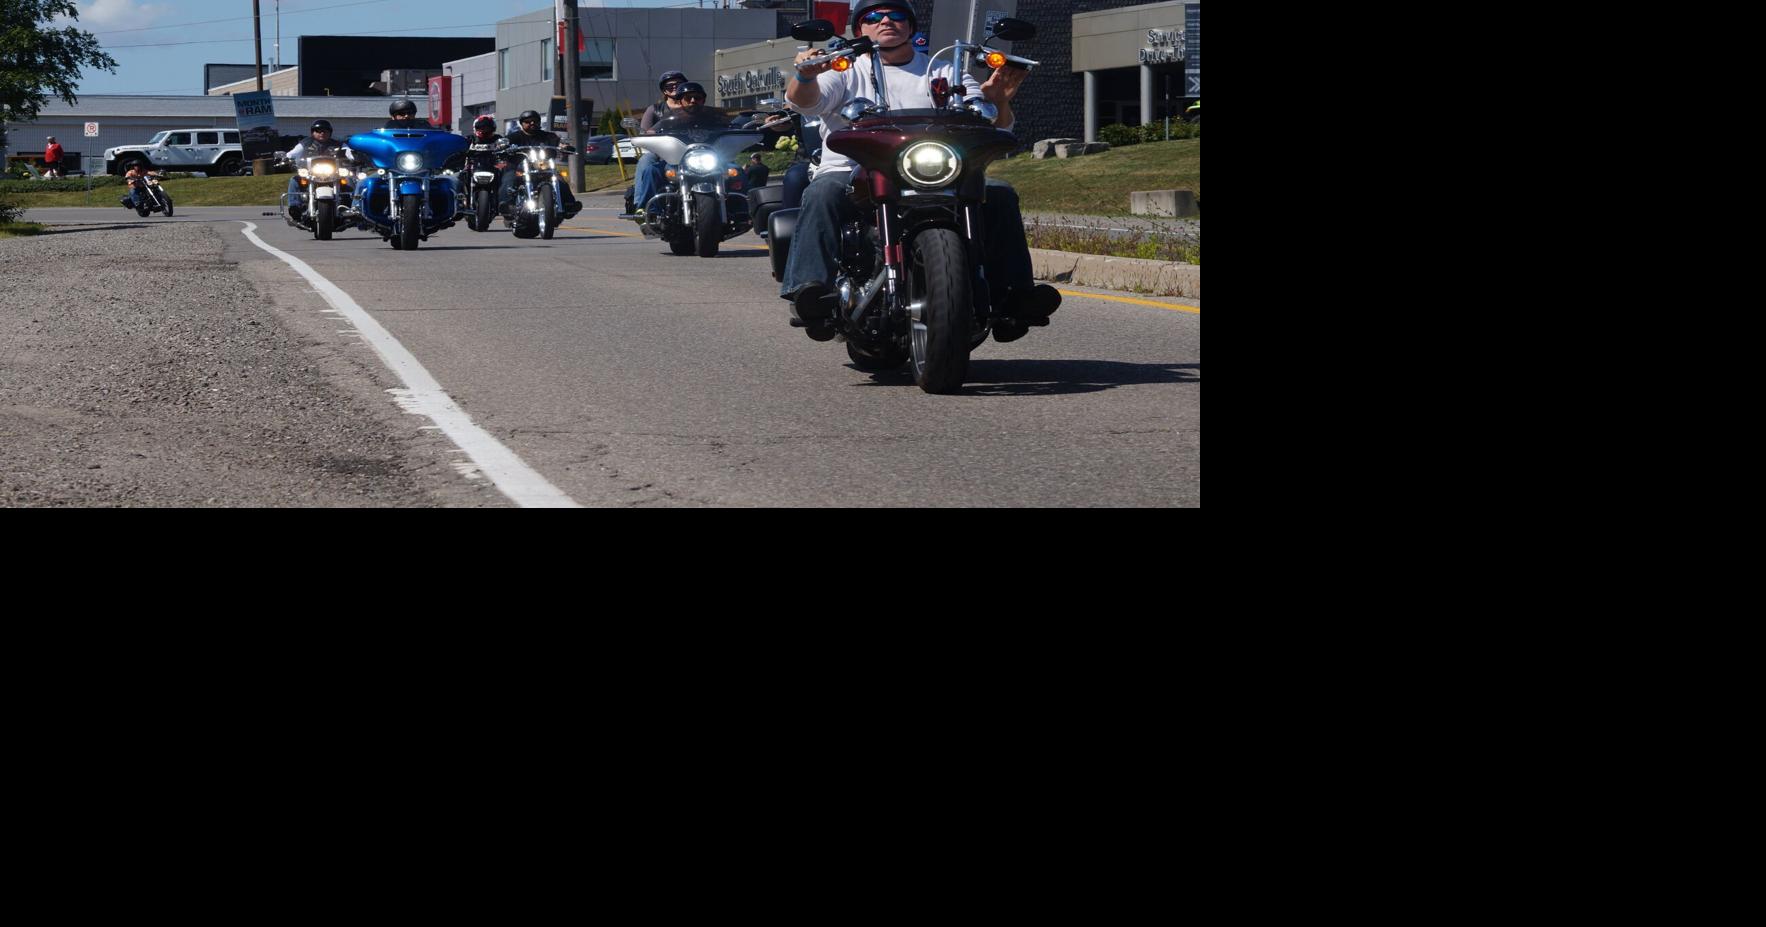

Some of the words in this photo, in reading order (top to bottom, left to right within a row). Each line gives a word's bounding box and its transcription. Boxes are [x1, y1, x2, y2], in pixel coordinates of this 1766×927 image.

[717, 72, 743, 93] South
[745, 66, 782, 89] Oakville
[237, 98, 271, 108] MONTH
[246, 105, 272, 116] RAM
